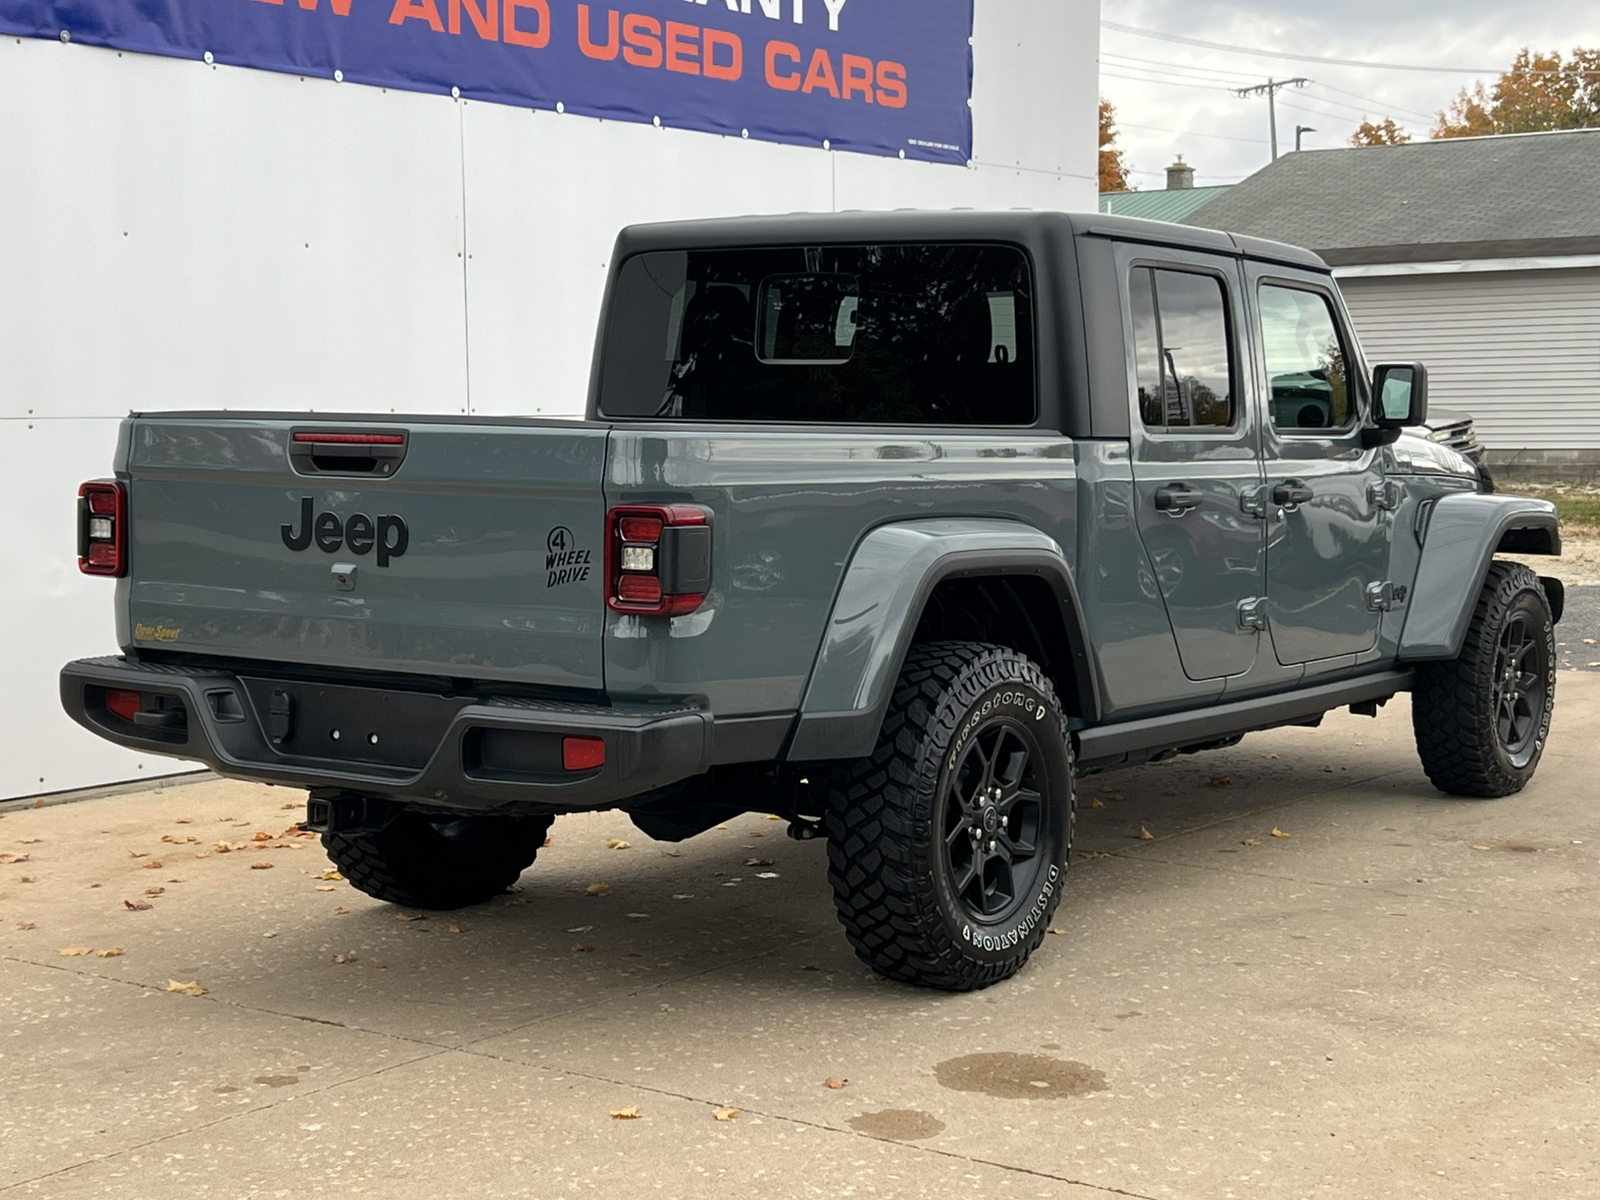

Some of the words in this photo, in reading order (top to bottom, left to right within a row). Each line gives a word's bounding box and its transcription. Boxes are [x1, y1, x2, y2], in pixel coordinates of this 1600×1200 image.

[388, 0, 551, 49] AND
[577, 3, 743, 82] USED
[764, 40, 908, 108] CARS
[280, 495, 410, 568] Jeep
[545, 549, 591, 571] WHEEL
[547, 566, 591, 588] DRIVE
[972, 864, 1060, 952] DESTINATION
